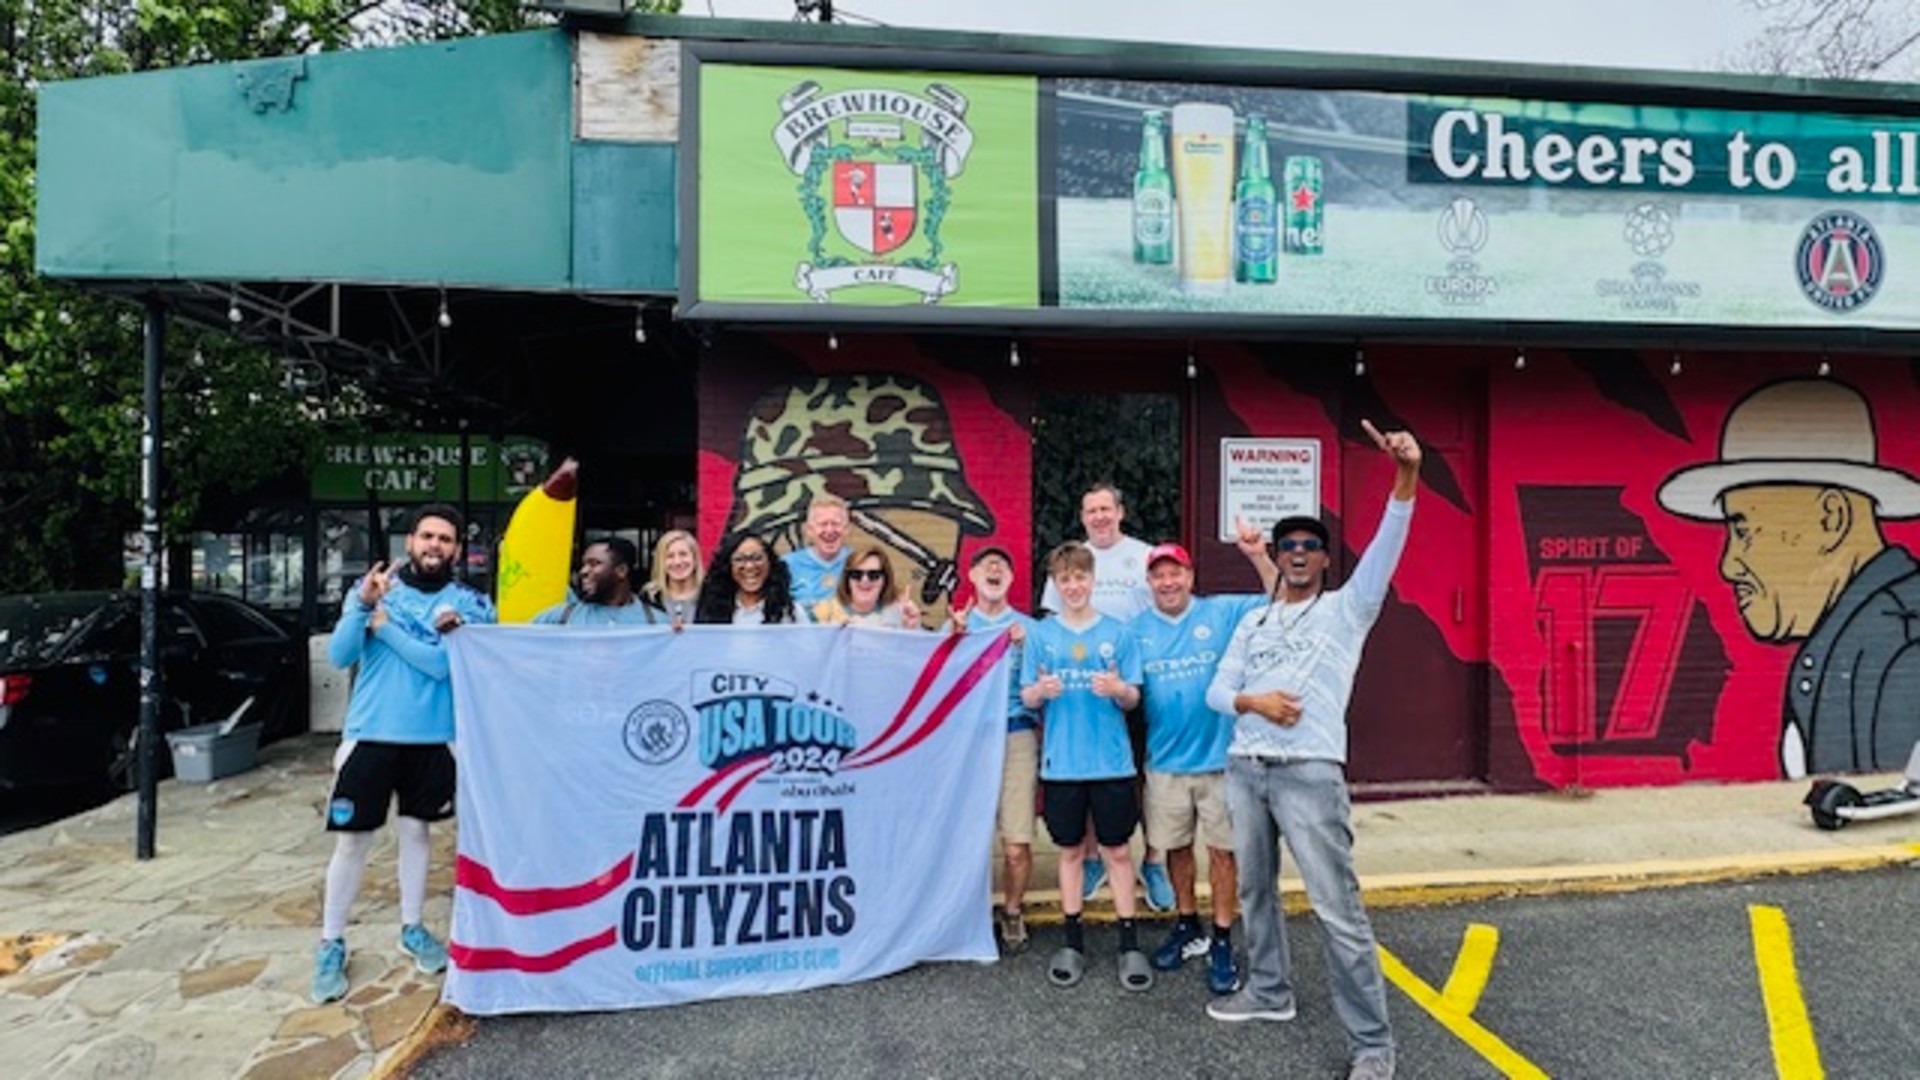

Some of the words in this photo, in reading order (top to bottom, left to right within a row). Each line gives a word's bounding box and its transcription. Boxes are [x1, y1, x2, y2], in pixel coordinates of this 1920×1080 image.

[785, 93, 965, 139] BREWHOUSE
[1432, 110, 1695, 186] Cheers
[1727, 130, 1797, 190] to
[1826, 129, 1920, 195] all
[1425, 277, 1498, 296] EUROPA
[1230, 448, 1312, 464] WARNING
[1539, 537, 1610, 560] SPIRIT
[1615, 536, 1643, 558] OF
[1535, 567, 1696, 742] 17
[710, 673, 769, 695] CITY
[698, 699, 767, 770] USA
[771, 700, 857, 750] TOUR
[768, 745, 842, 777] 2024
[636, 811, 847, 879] ATLANTA
[622, 876, 857, 952] CITYZENS
[634, 957, 701, 985] OFFICIAL
[704, 949, 799, 979] SUPPORTERS
[803, 946, 841, 970] CLUB
